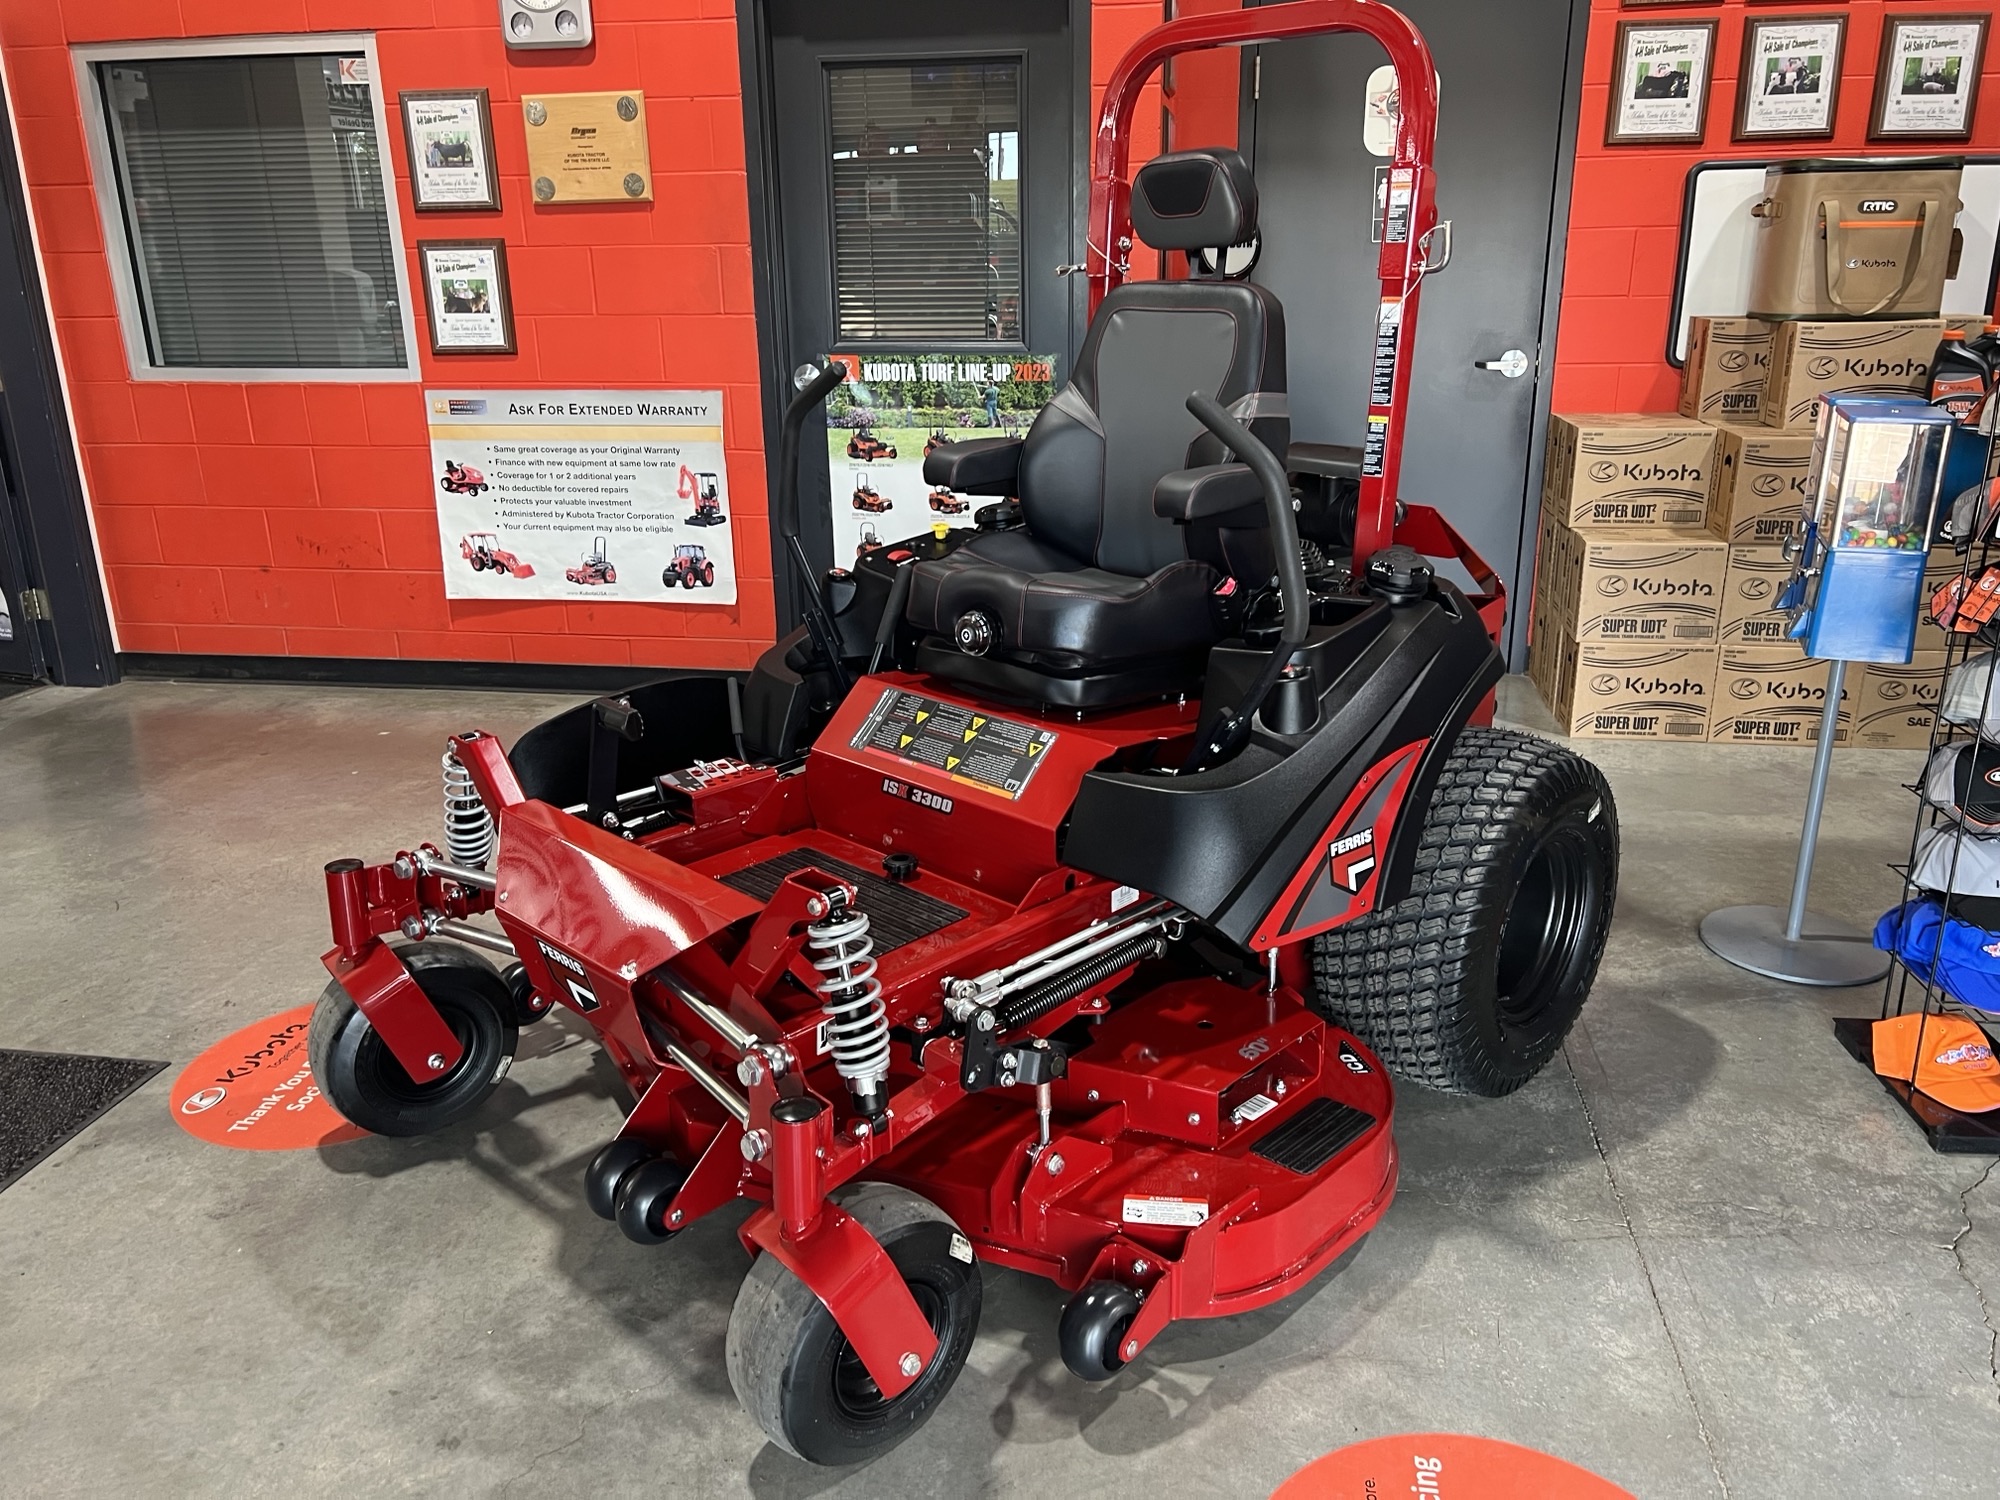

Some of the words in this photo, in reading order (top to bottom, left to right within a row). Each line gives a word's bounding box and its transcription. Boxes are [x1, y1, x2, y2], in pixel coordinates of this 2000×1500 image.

[1644, 45, 1655, 56] Sale
[1656, 44, 1661, 54] of
[1662, 44, 1688, 54] Champions
[1773, 41, 1784, 53] Sale
[1785, 40, 1791, 50] of
[1792, 39, 1818, 49] Champions
[1913, 41, 1924, 52] Sale
[1925, 40, 1930, 49] of
[1931, 39, 1959, 49] Champions
[423, 115, 433, 125] Sale
[433, 114, 437, 123] of
[438, 114, 459, 123] Champions
[1863, 202, 1894, 211] RTIC
[442, 264, 451, 273] Sale
[456, 263, 476, 271] Champions
[1862, 259, 1896, 267] Kubota
[863, 362, 916, 382] KUBOTA
[920, 363, 954, 382] TURF
[958, 363, 1011, 382] LINE-UP
[1014, 363, 1051, 382] 2023
[1844, 358, 1927, 377] Kubota
[1722, 394, 1758, 408] SUPER
[518, 446, 538, 455] great
[610, 446, 642, 455] Original
[644, 447, 680, 455] Warranty
[497, 472, 534, 480] Coverage
[1624, 464, 1701, 481] Kubota
[555, 511, 564, 519] by
[626, 512, 674, 520] Corporation
[1594, 504, 1628, 518] SUPER
[645, 526, 673, 534] eligible
[1756, 520, 1793, 534] SUPER
[1633, 578, 1712, 596] Kubota
[1602, 619, 1638, 633] SUPER
[1743, 622, 1780, 636] SUPER
[1626, 677, 1703, 695] Kubota
[1767, 682, 1848, 700] Kuboa
[1595, 716, 1630, 730] SUPER
[1734, 720, 1770, 734] SUPER
[1907, 718, 1931, 726] SAE
[883, 779, 907, 798] ISX
[912, 789, 953, 812] 3300
[1330, 829, 1372, 857] FERRIS
[538, 941, 585, 976] FERRIS
[216, 1024, 308, 1082] Kubota
[1340, 1054, 1368, 1074] iCD
[227, 1093, 285, 1132] Thank
[274, 1066, 312, 1091] You
